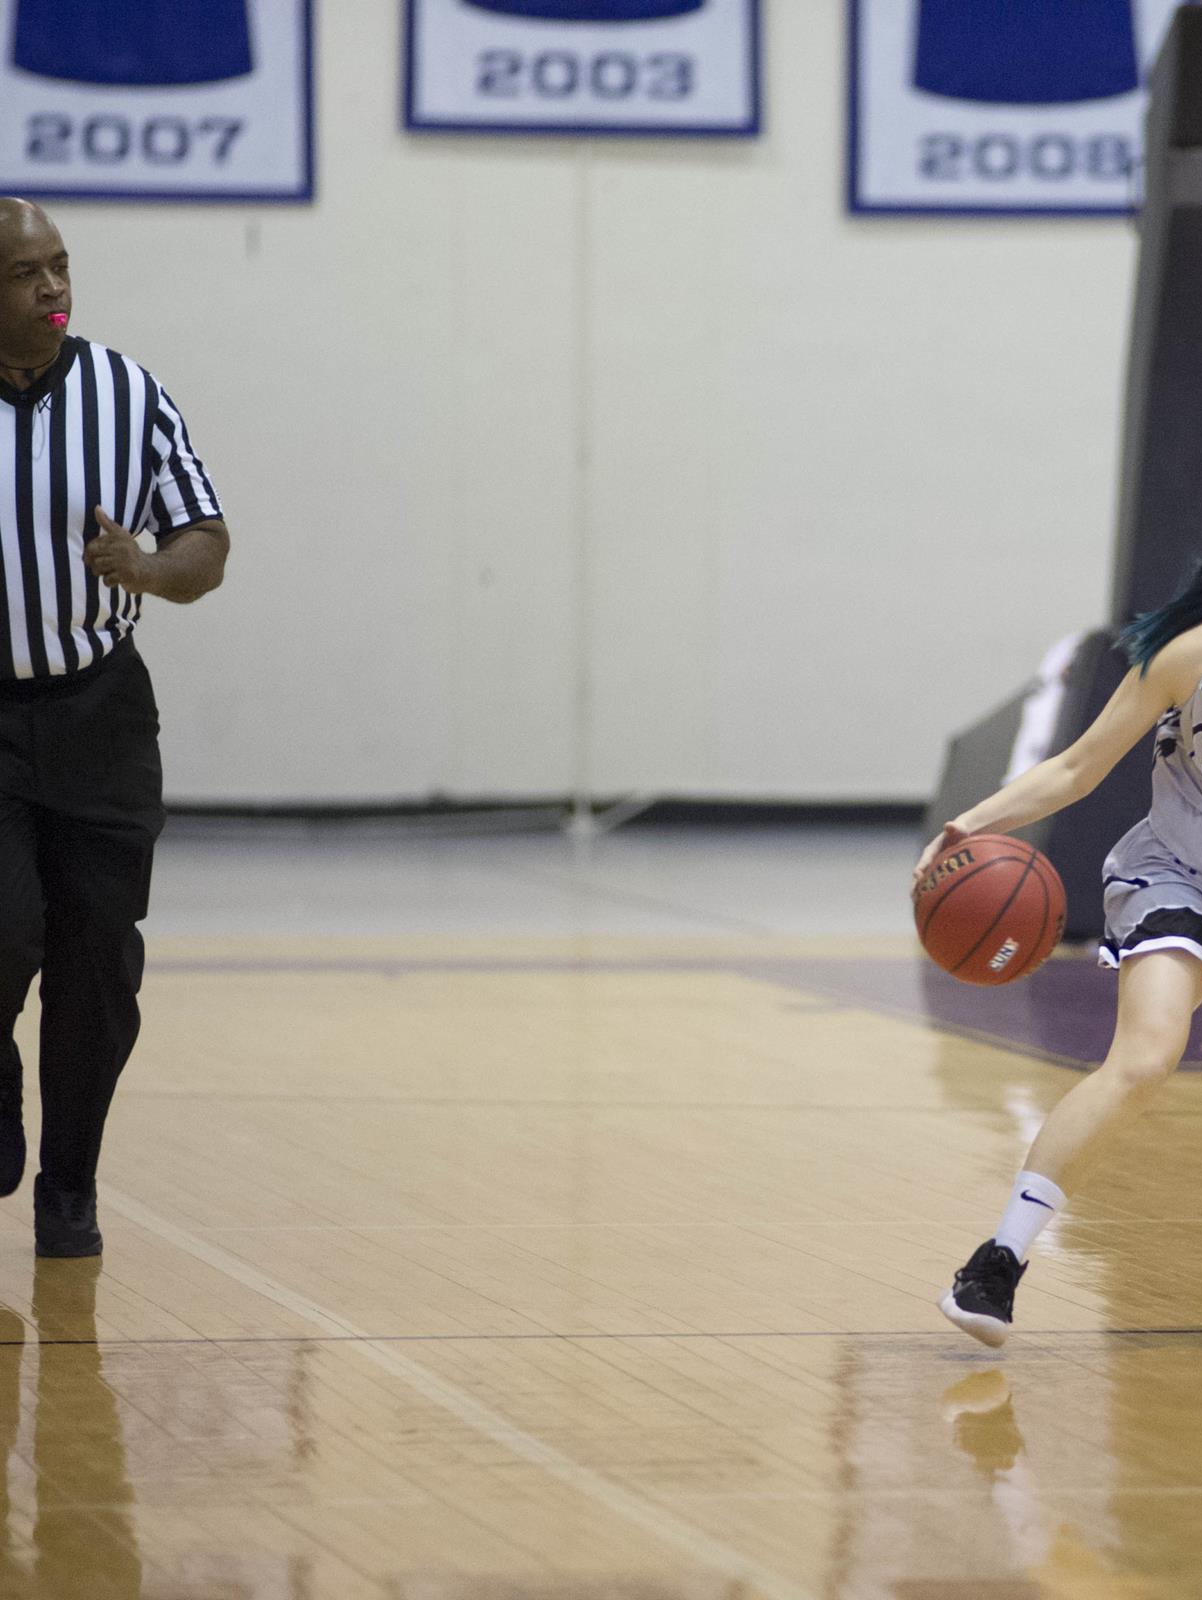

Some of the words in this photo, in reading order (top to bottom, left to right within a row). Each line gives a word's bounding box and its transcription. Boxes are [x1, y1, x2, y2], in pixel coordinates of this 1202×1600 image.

[476, 49, 693, 100] 2003
[25, 112, 243, 167] 2007
[919, 132, 1135, 182] 2008
